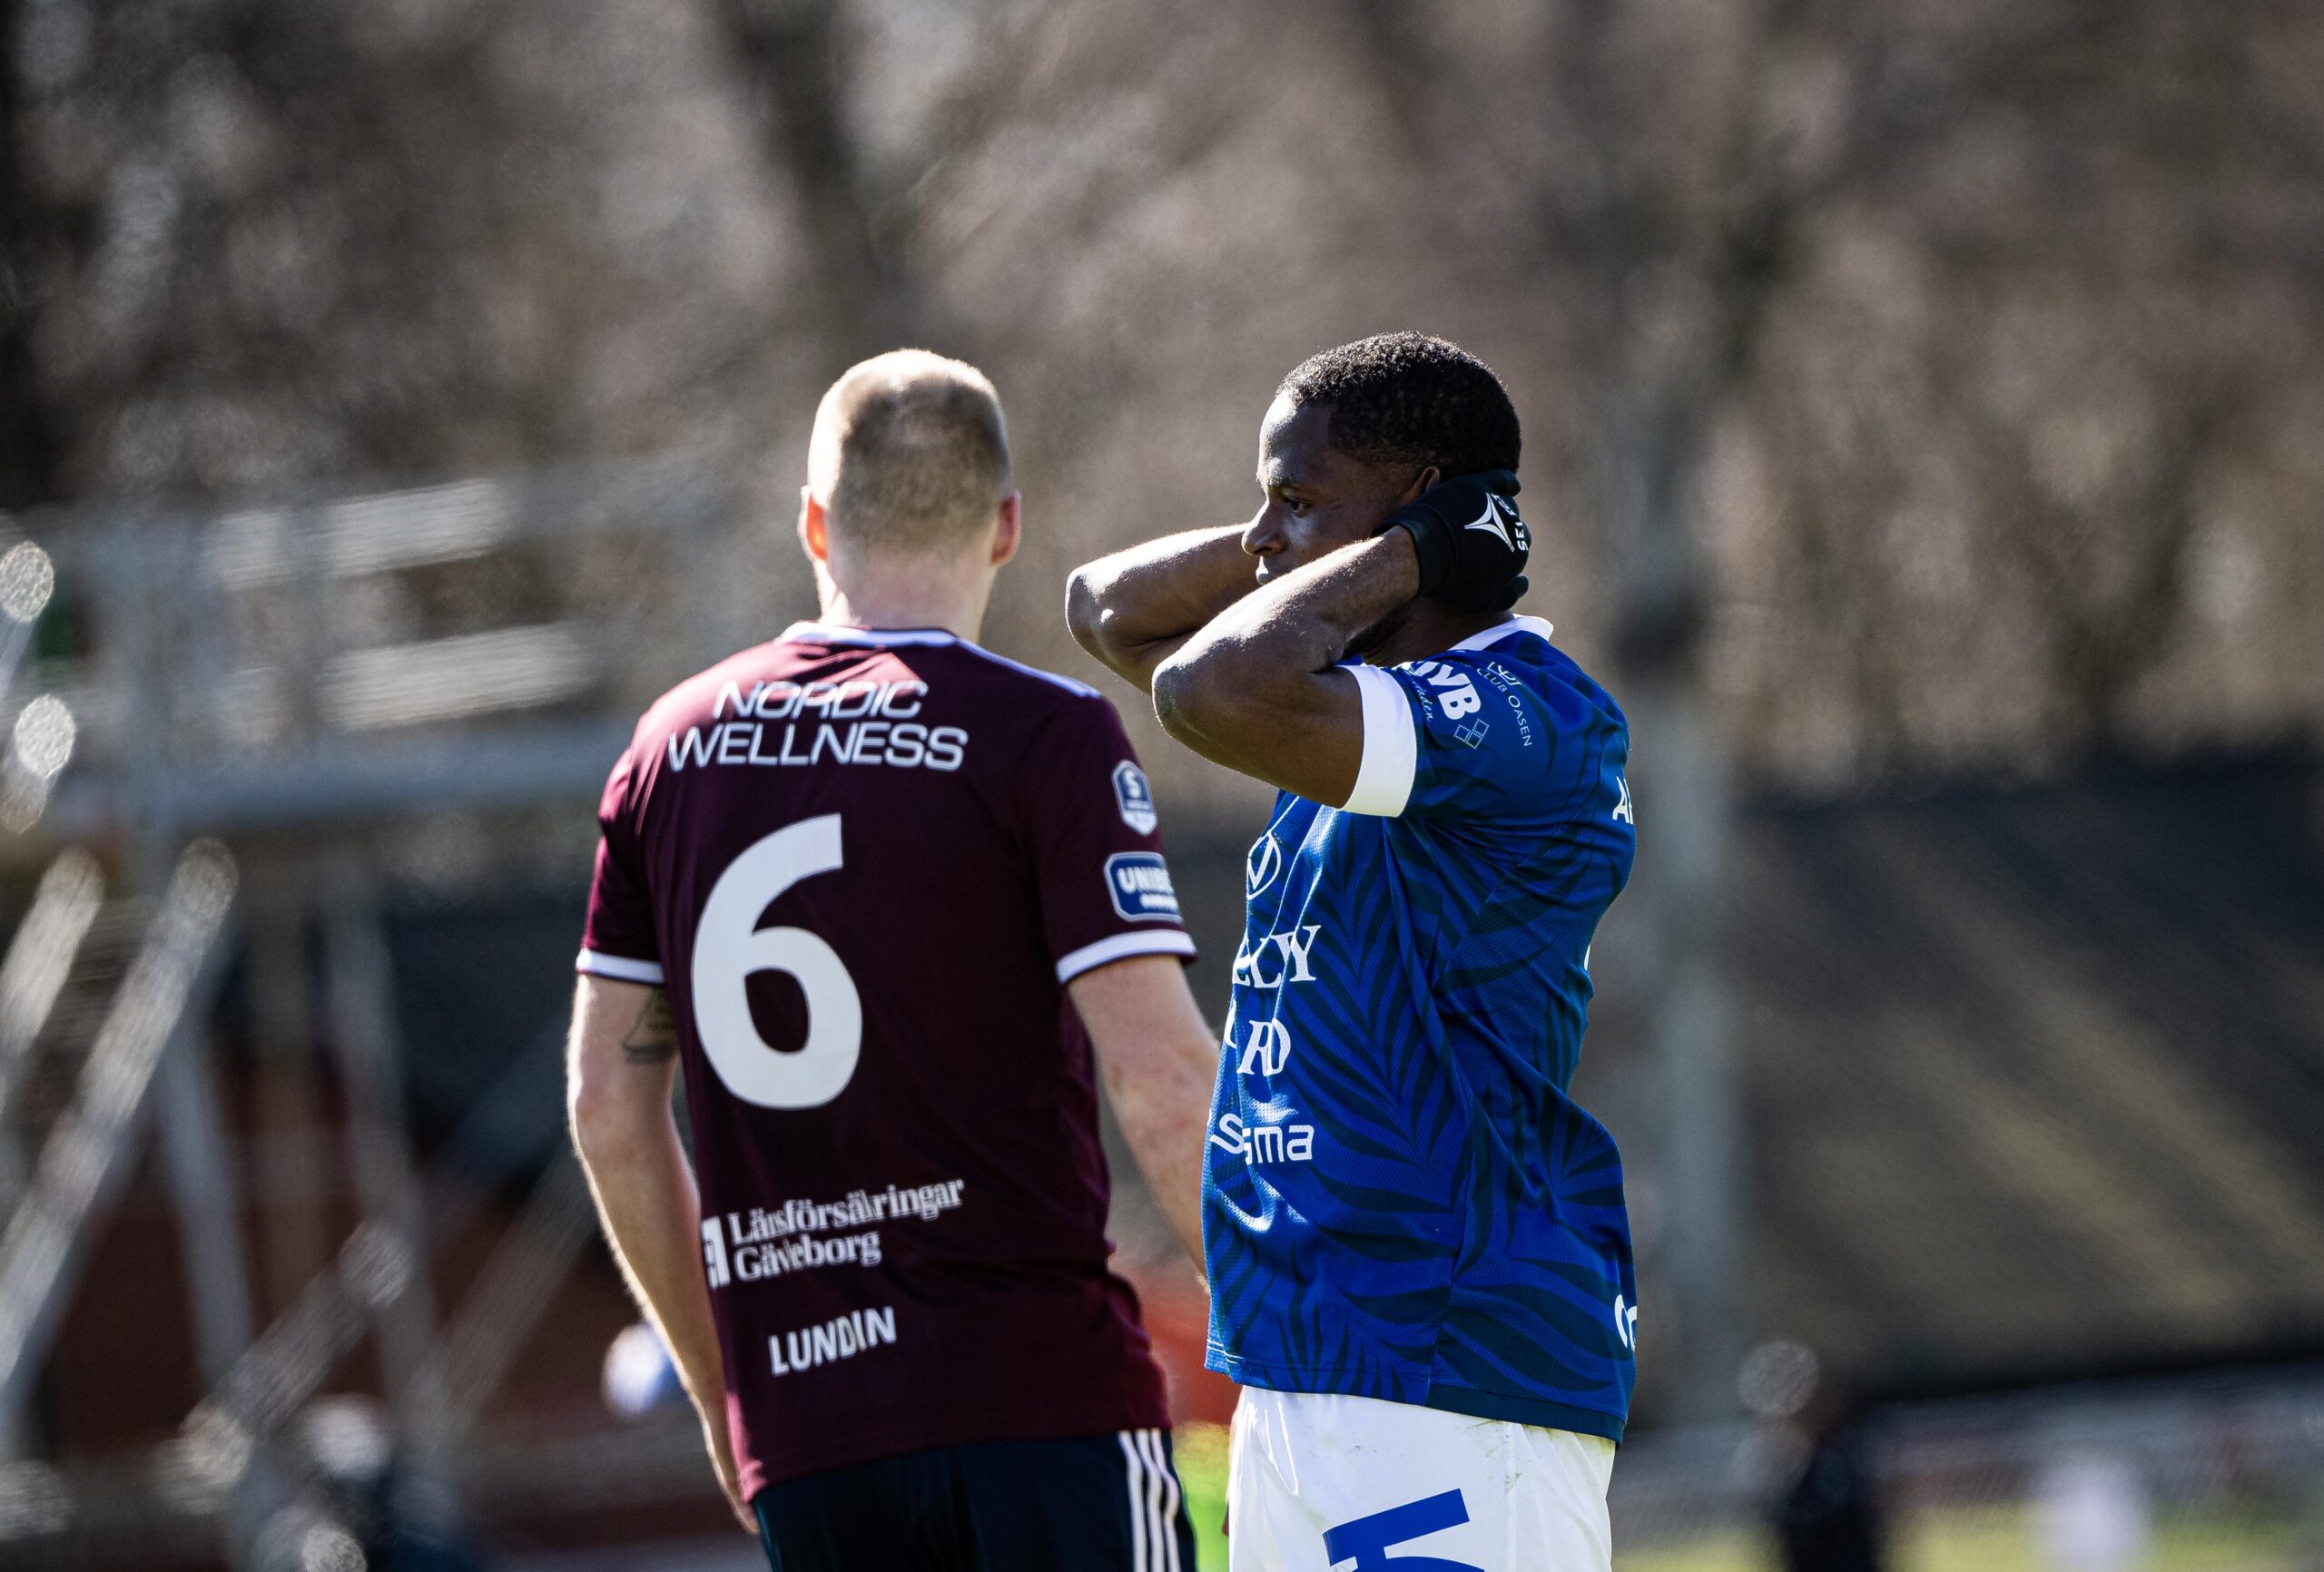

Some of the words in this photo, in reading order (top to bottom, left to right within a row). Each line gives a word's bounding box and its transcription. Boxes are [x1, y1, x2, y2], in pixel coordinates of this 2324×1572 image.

[712, 680, 929, 720] NORDIC
[1476, 667, 1508, 693] CLUB
[1507, 694, 1533, 748] OASEN
[666, 722, 969, 771] WELLNESS
[691, 813, 863, 1109] 6
[768, 1305, 897, 1378] LUNDIN
